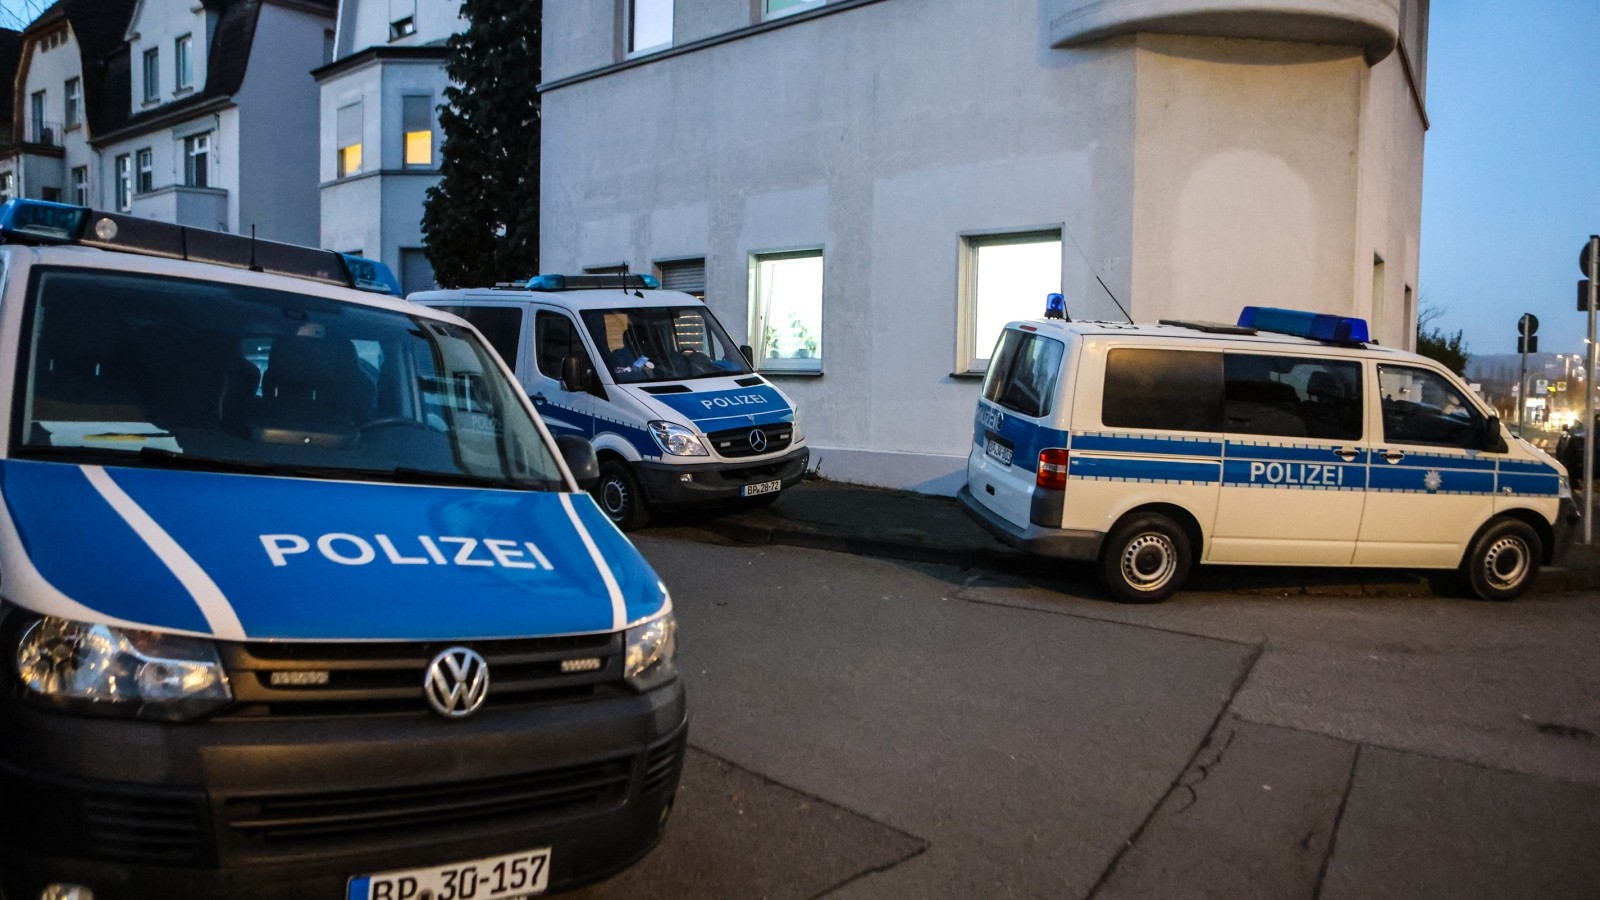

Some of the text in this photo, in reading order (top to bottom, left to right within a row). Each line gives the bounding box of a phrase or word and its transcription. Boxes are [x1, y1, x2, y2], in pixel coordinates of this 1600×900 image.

[700, 394, 768, 410] POLIZEI
[747, 481, 779, 495] BP 28-72
[1250, 462, 1343, 486] POLIZEI
[259, 533, 554, 570] POLIZEI
[424, 646, 489, 716] VW
[371, 854, 548, 900] BP 30-157
